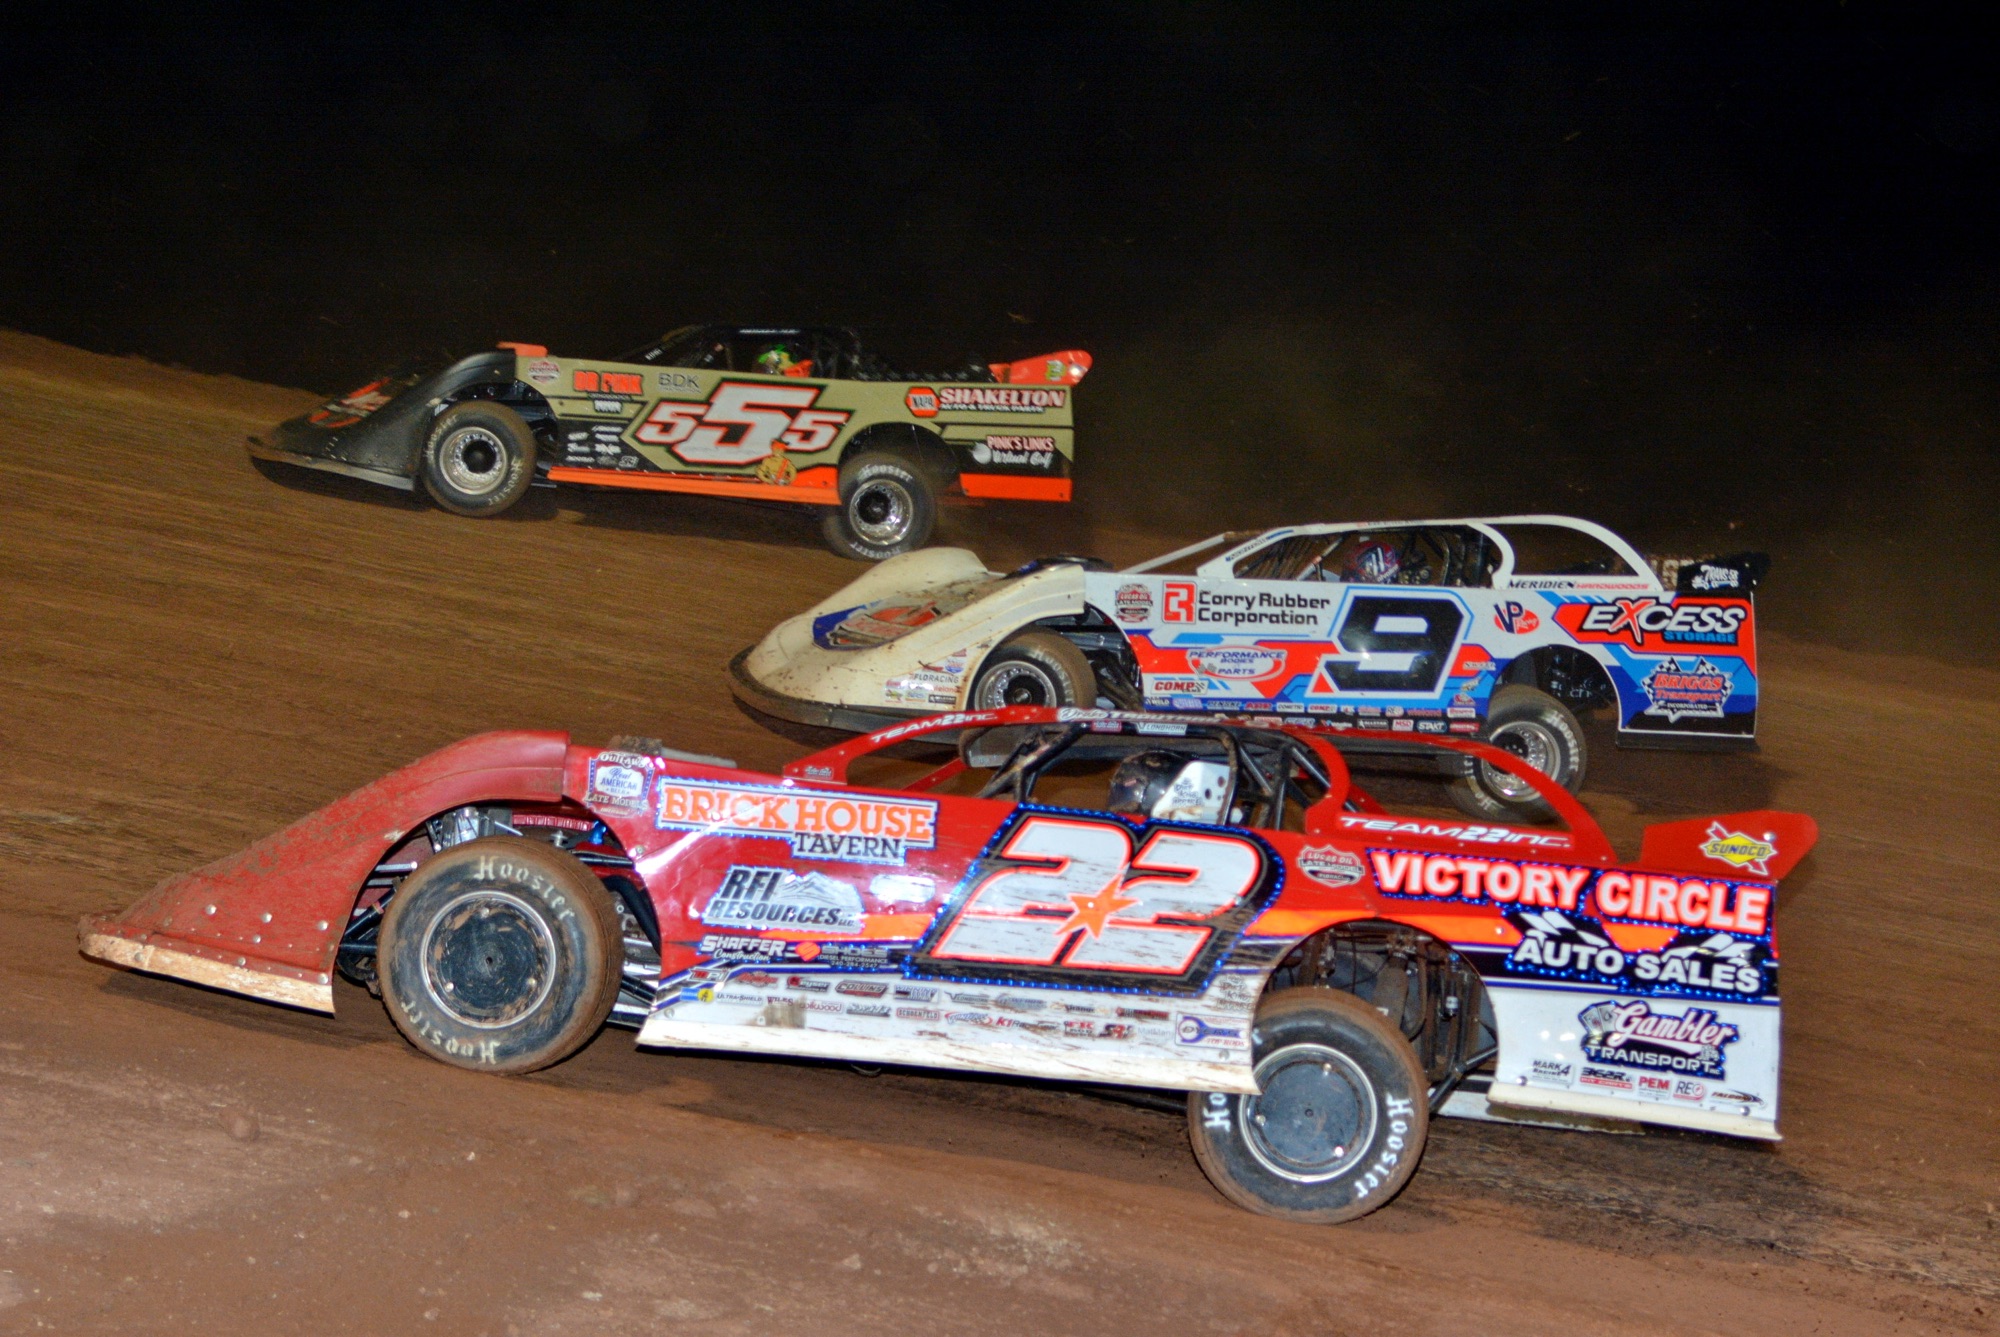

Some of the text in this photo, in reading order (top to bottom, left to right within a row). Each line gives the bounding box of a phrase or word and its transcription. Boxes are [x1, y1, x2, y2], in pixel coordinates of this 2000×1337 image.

[658, 373, 699, 388] BDK
[940, 386, 1065, 407] SHAKELTON
[1199, 590, 1330, 610] Corry Rubber
[1198, 608, 1318, 626] Corporation
[1494, 600, 1523, 634] VP
[1582, 599, 1745, 643] EXCESS
[1324, 595, 1464, 692] 9
[1664, 630, 1735, 643] STORAGE
[1189, 651, 1284, 660] PERFORMANCE
[1218, 667, 1255, 675] PARTS
[1154, 681, 1195, 691] COMP
[1653, 673, 1723, 691] BRIGGS
[1146, 724, 1186, 732] LONGHORN
[601, 777, 638, 790] AMERICAN
[587, 793, 609, 804] LATE
[661, 785, 933, 840] BRICK HOUSE
[794, 833, 900, 860] TAVERN
[1707, 841, 1770, 860] SUNOCO
[1308, 852, 1353, 865] LUCAS OIL
[474, 855, 576, 920] Hoosier
[720, 869, 784, 901] RFI
[930, 815, 1262, 975] 22
[1370, 850, 1770, 934] VICTORY CIRCLE
[707, 899, 839, 925] RESOURCES
[702, 934, 787, 957] SHAFFER
[713, 948, 771, 962] Construction
[841, 956, 888, 964] PERFORMANCE
[1513, 935, 1760, 993] AUTO SALES
[401, 1000, 500, 1065] Hoosier
[1606, 1001, 1736, 1048] Gambler
[1533, 1060, 1561, 1071] MARK
[1588, 1045, 1715, 1072] TRANSPORT
[1639, 1076, 1670, 1090] PEM
[1354, 1092, 1415, 1199] Hoosier
